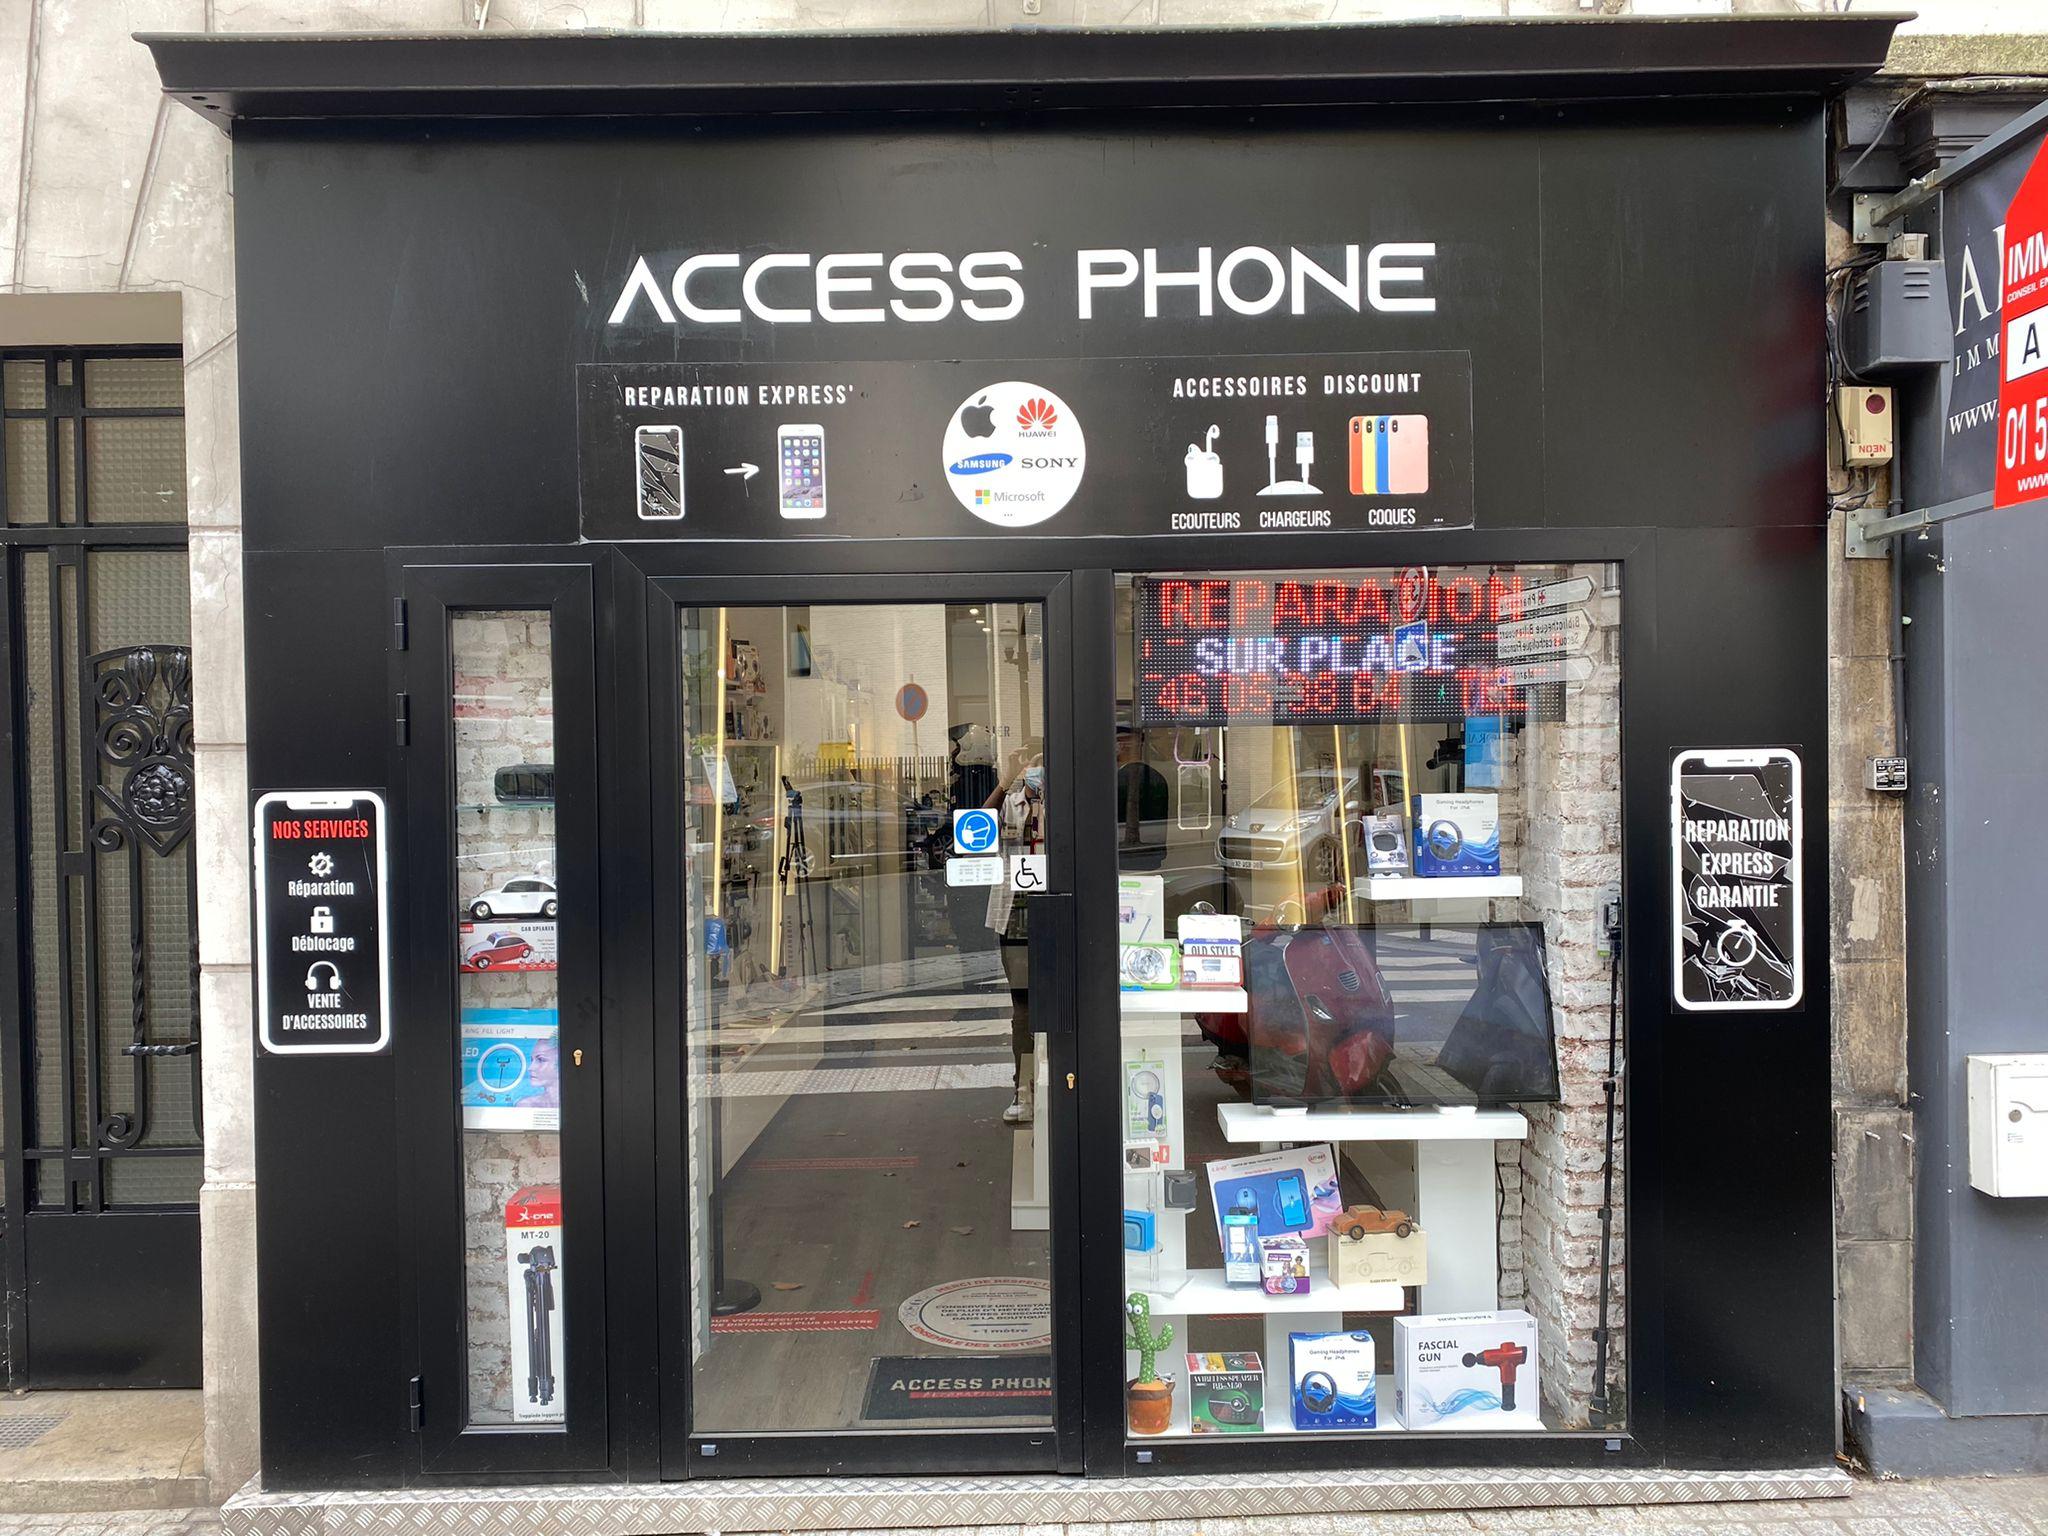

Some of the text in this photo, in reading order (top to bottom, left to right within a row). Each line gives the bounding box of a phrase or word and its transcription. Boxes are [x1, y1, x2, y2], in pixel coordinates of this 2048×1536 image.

[607, 242, 1436, 324] ACCESS PHONE
[1173, 373, 1422, 398] ACCESSOIRES DISCOUNT
[624, 386, 749, 406] REPARATION
[2005, 403, 2027, 470] 01
[957, 459, 1006, 470] SAMSUNG
[1021, 457, 1078, 469] SONY
[994, 491, 1045, 502] Microsoft
[1171, 512, 1241, 530] ECOUTEURS
[1259, 509, 1331, 528] CHARGEURS
[1368, 507, 1416, 526] COQUES
[1160, 576, 1524, 629] REPARATION
[1196, 636, 1284, 674] SUR
[273, 820, 369, 839] NOS SERVICES
[1685, 818, 1789, 842] REPARATION
[1701, 852, 1774, 875] EXPRESS
[288, 880, 354, 897] Réparation
[1696, 885, 1778, 908] GARANTIE
[291, 934, 354, 952] Déblocage
[307, 993, 341, 1009] VENTE
[282, 1013, 367, 1031] D'ACCESSOIRES
[521, 1231, 550, 1239] MT-20
[1418, 1340, 1459, 1350] FASCIAL
[1418, 1352, 1441, 1362] GUN
[890, 1376, 1051, 1391] ACCESS PHON
